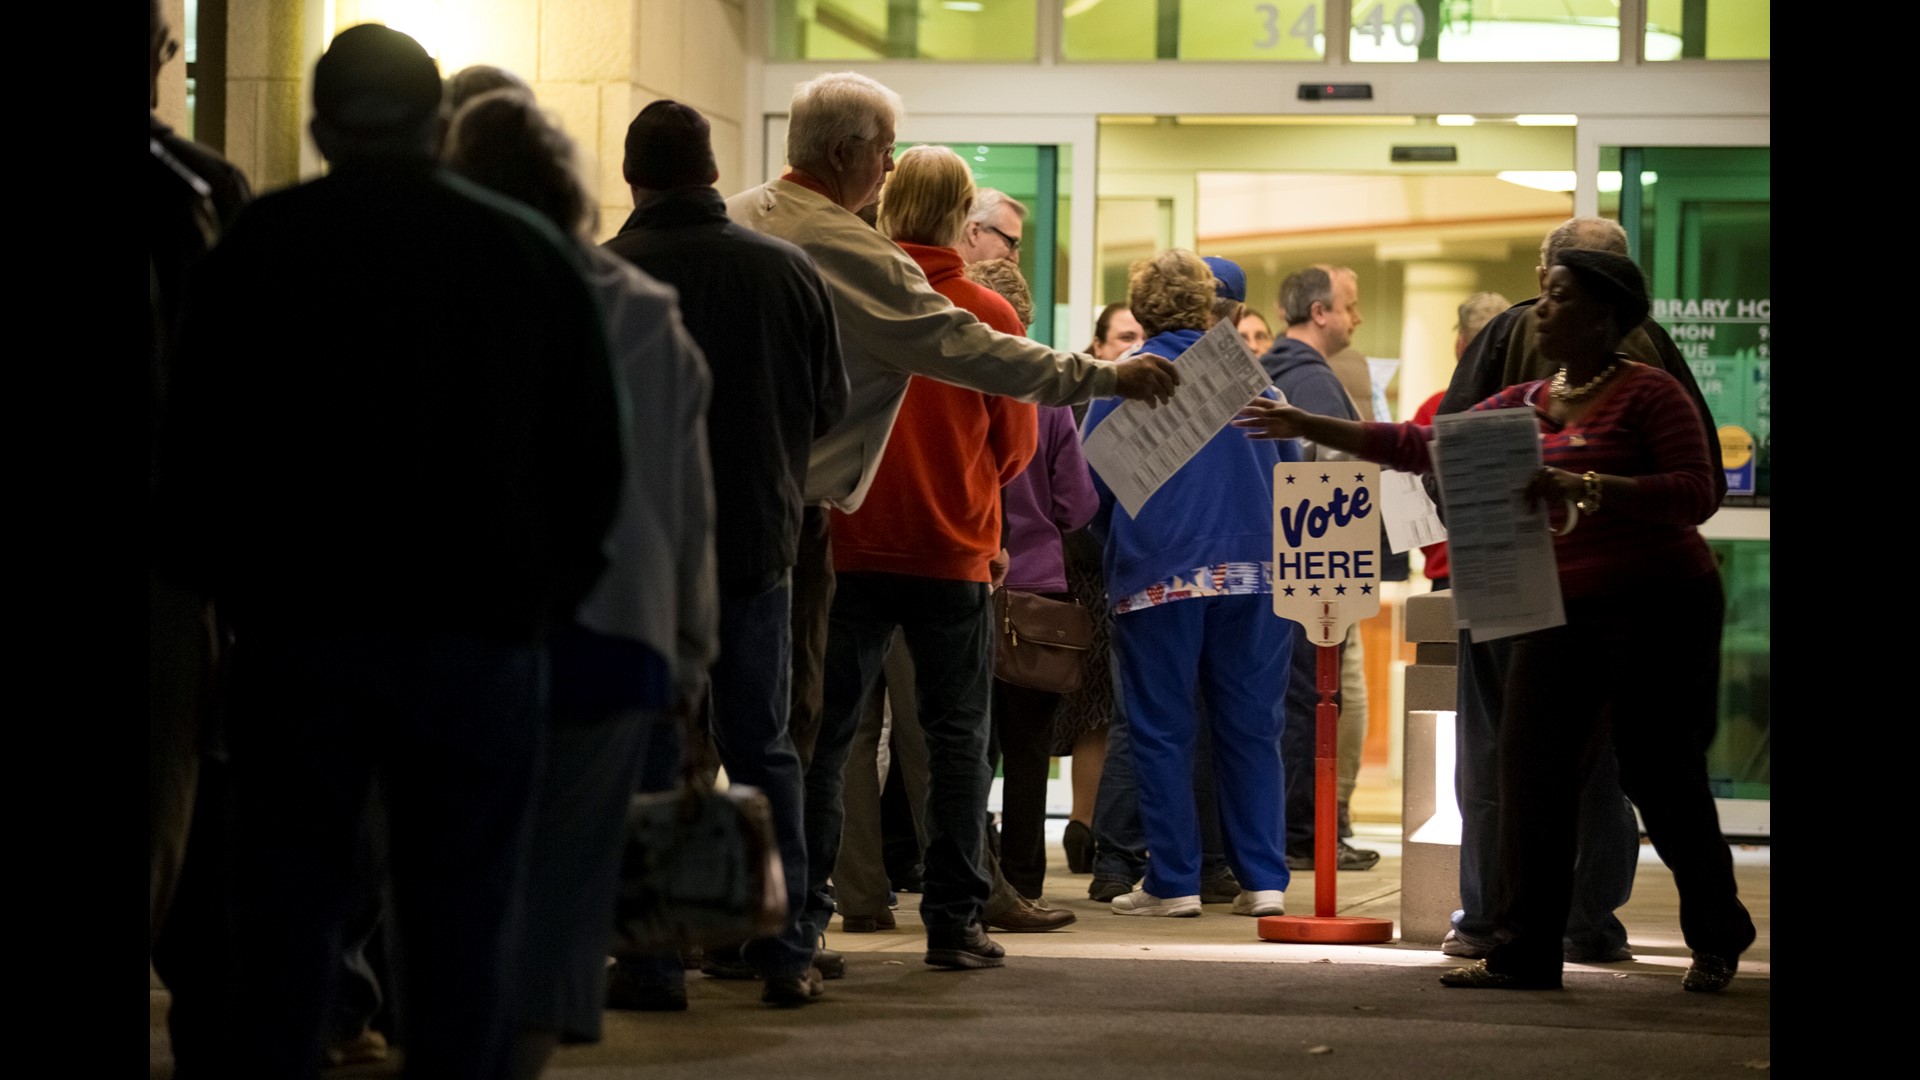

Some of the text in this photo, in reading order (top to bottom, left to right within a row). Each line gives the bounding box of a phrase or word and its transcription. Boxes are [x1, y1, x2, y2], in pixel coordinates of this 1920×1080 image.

[1670, 324, 1716, 341] MON
[1280, 486, 1372, 548] Vote
[1279, 550, 1375, 580] HERE
